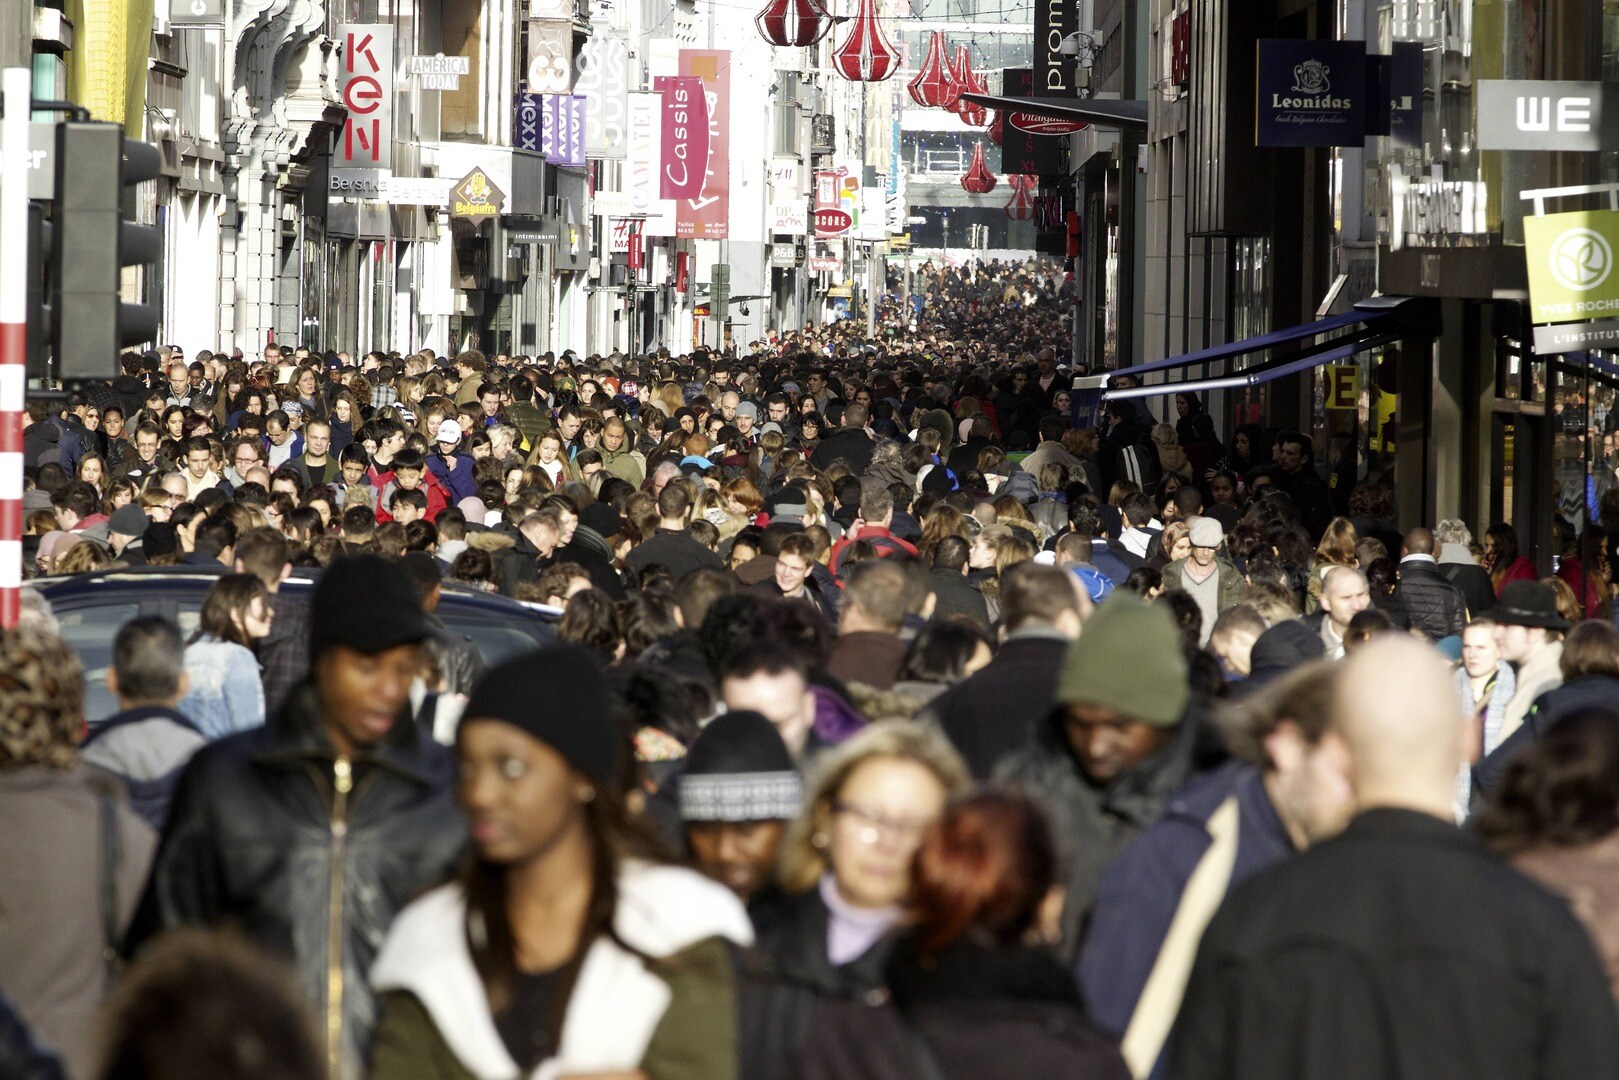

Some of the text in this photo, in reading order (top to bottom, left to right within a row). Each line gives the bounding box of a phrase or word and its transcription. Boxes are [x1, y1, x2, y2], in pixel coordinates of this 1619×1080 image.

[413, 58, 466, 73] AMERICA
[422, 74, 458, 90] TODAY
[1272, 93, 1351, 109] Leonidas
[1516, 96, 1591, 132] WE
[666, 88, 688, 187] Cassis
[815, 215, 846, 227] SCORE
[774, 247, 794, 258] P&B
[1539, 302, 1573, 316] YVES
[1554, 330, 1619, 344] L'INSTITUT
